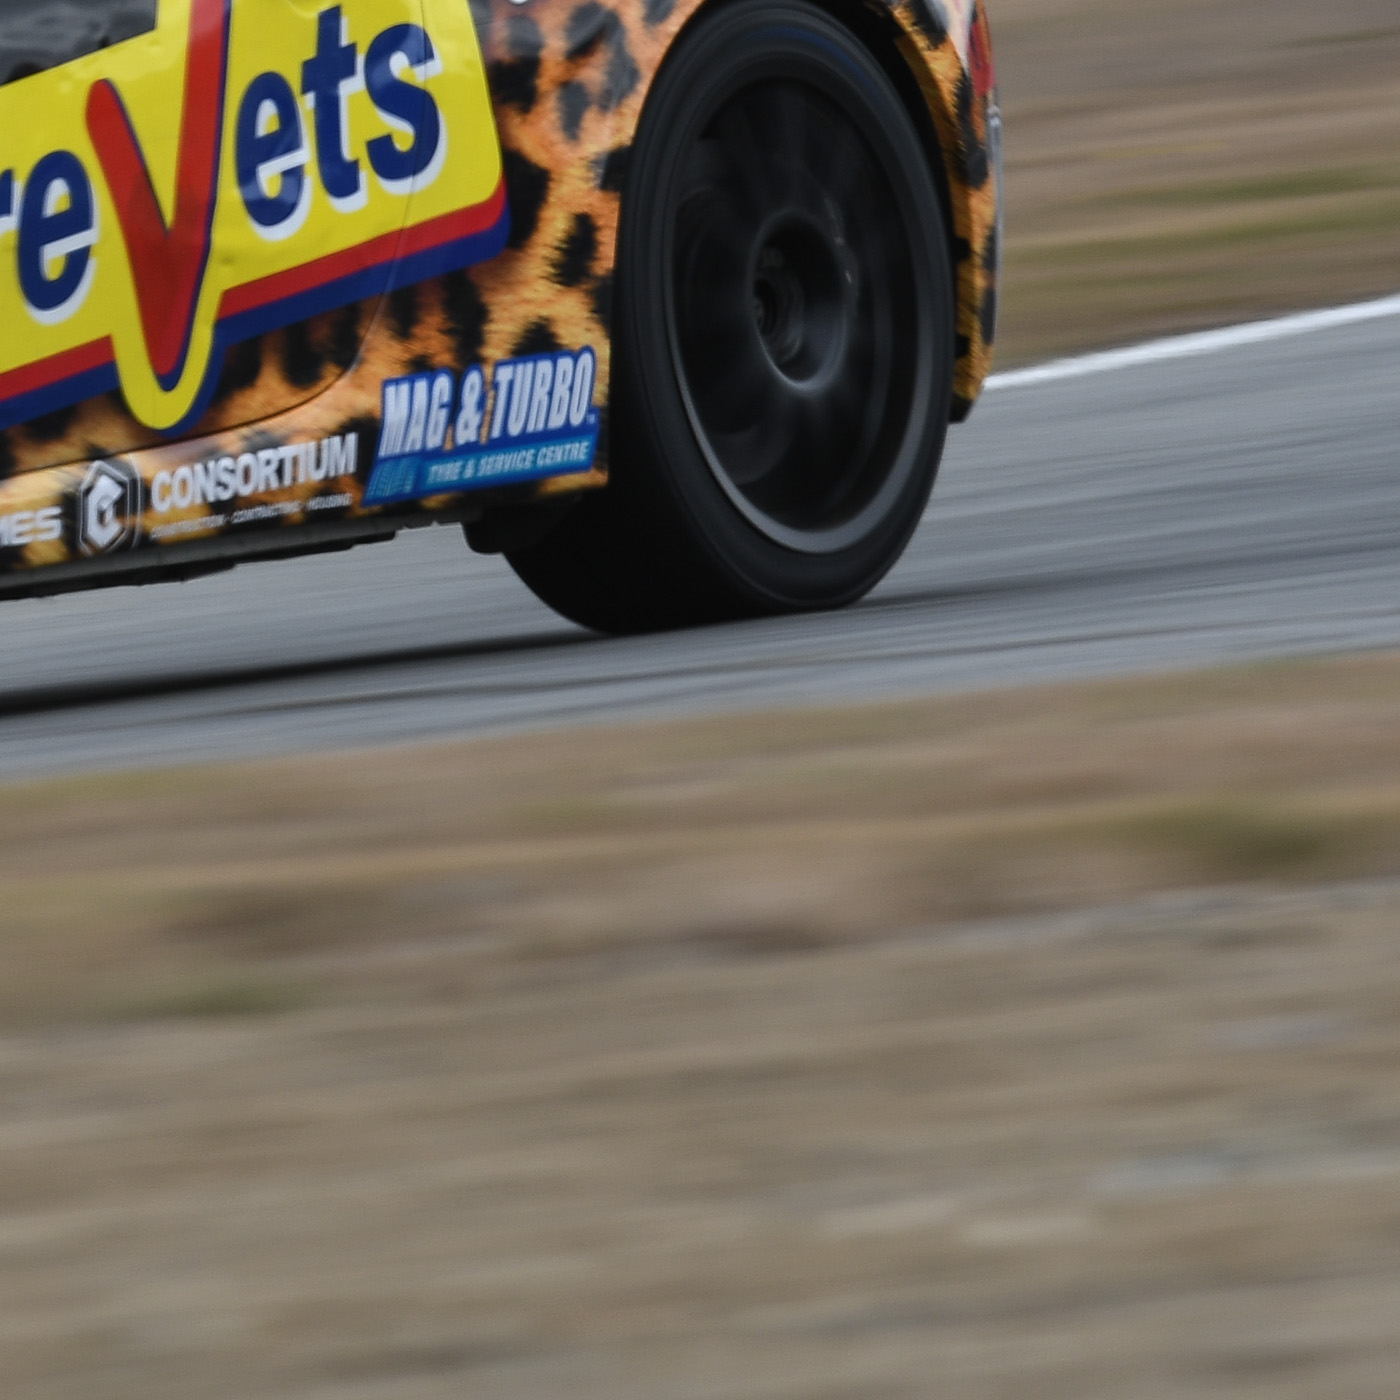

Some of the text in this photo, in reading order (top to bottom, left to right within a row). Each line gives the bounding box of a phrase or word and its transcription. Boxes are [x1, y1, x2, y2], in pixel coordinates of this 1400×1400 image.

[378, 351, 594, 459] MAG & TURBO
[151, 432, 359, 514] CONSORTIUM
[426, 464, 463, 485] TYRE
[477, 450, 537, 477] SERVICE
[537, 441, 589, 467] CENTRE
